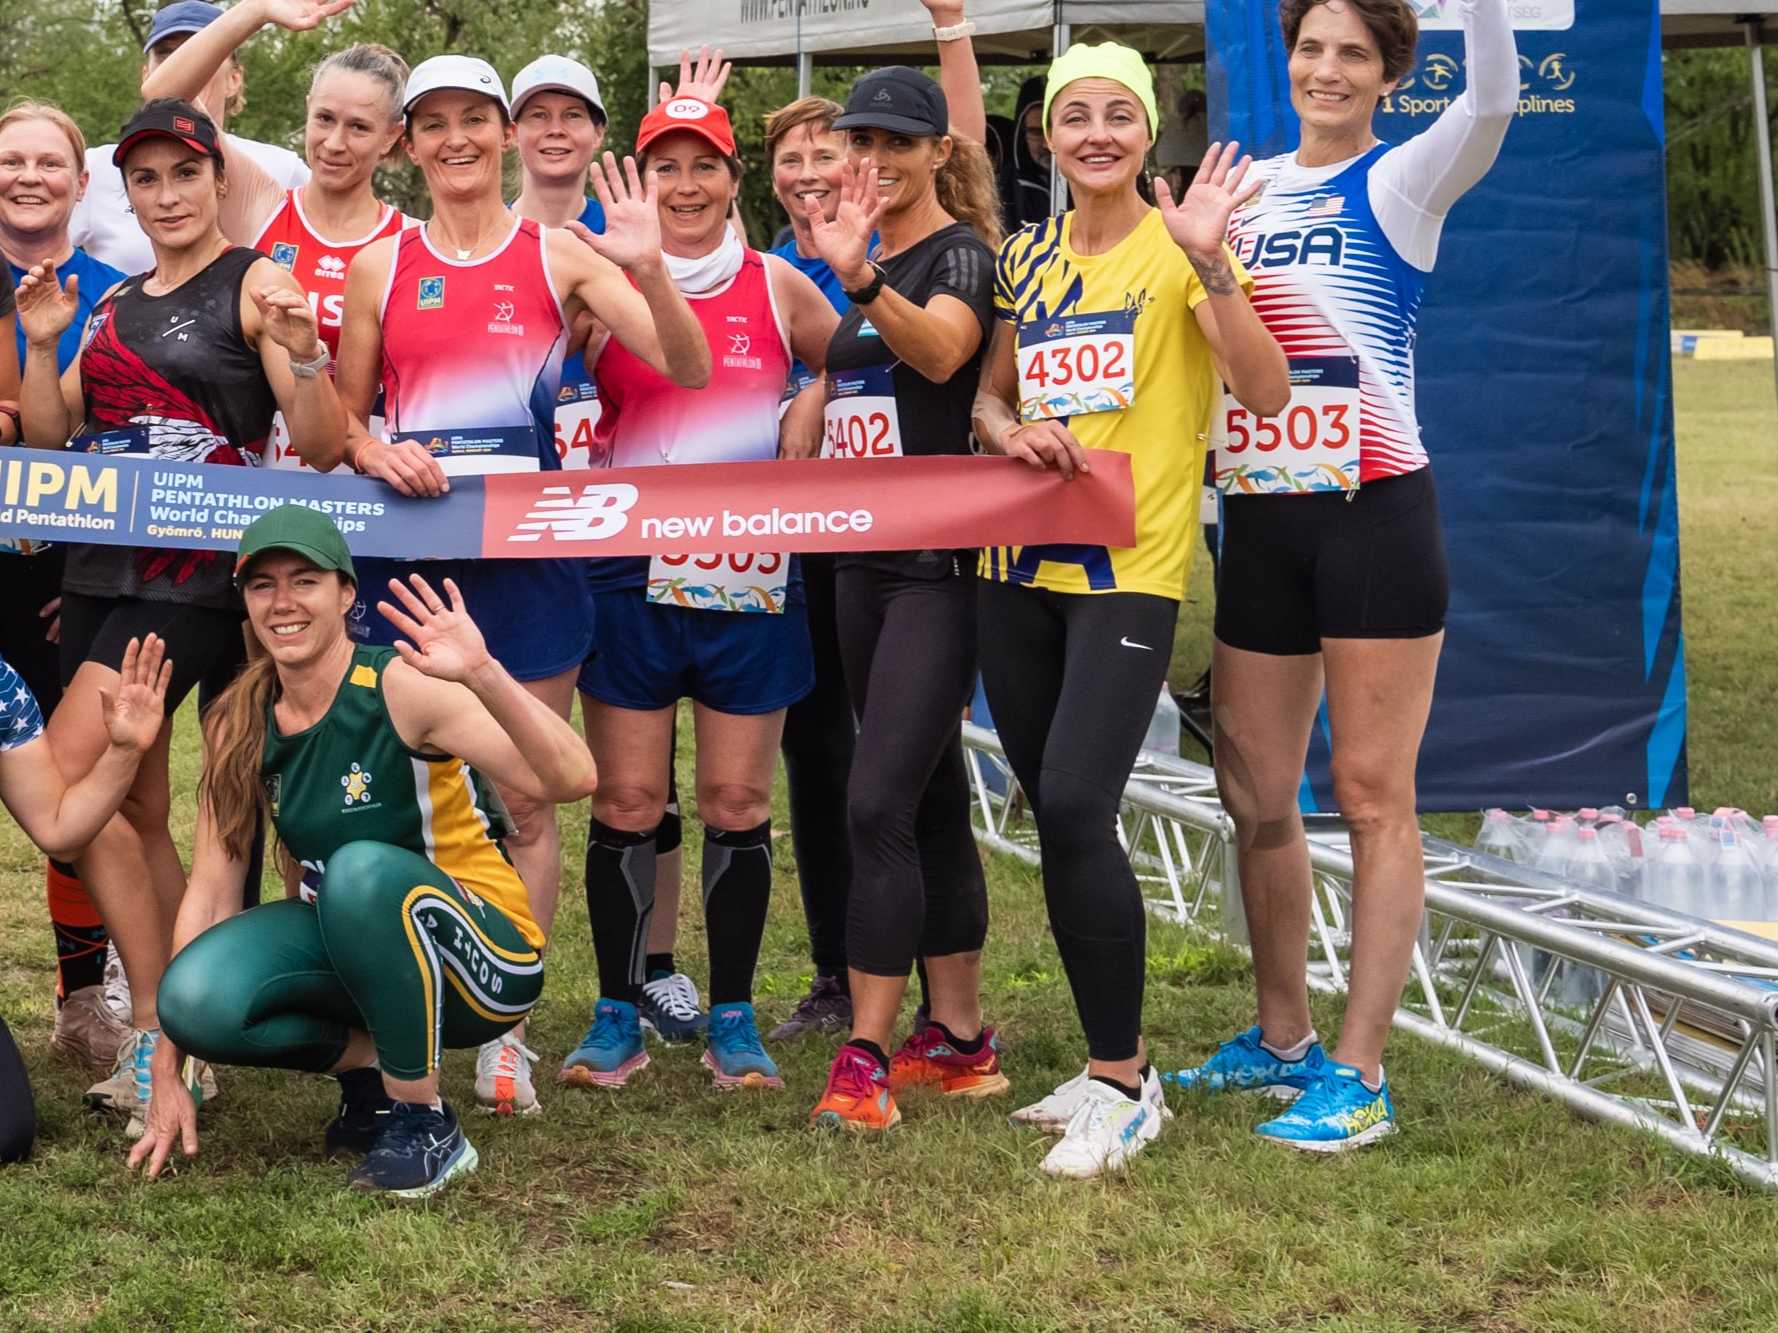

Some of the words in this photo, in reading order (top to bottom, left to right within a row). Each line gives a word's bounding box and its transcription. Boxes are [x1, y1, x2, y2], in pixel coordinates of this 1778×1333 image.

[1382, 96, 1395, 113] 1
[1399, 95, 1450, 116] Sport
[1235, 224, 1344, 268] USA
[1025, 340, 1126, 388] 4302
[827, 411, 895, 457] 5402
[1225, 404, 1350, 454] 5503
[153, 471, 204, 489] UIPM
[149, 506, 209, 524] World
[151, 488, 286, 511] PENTATHLON
[16, 509, 115, 531] Pentathlon
[641, 515, 714, 539] new
[722, 508, 874, 538] balance
[1340, 1096, 1389, 1137] HOKA
